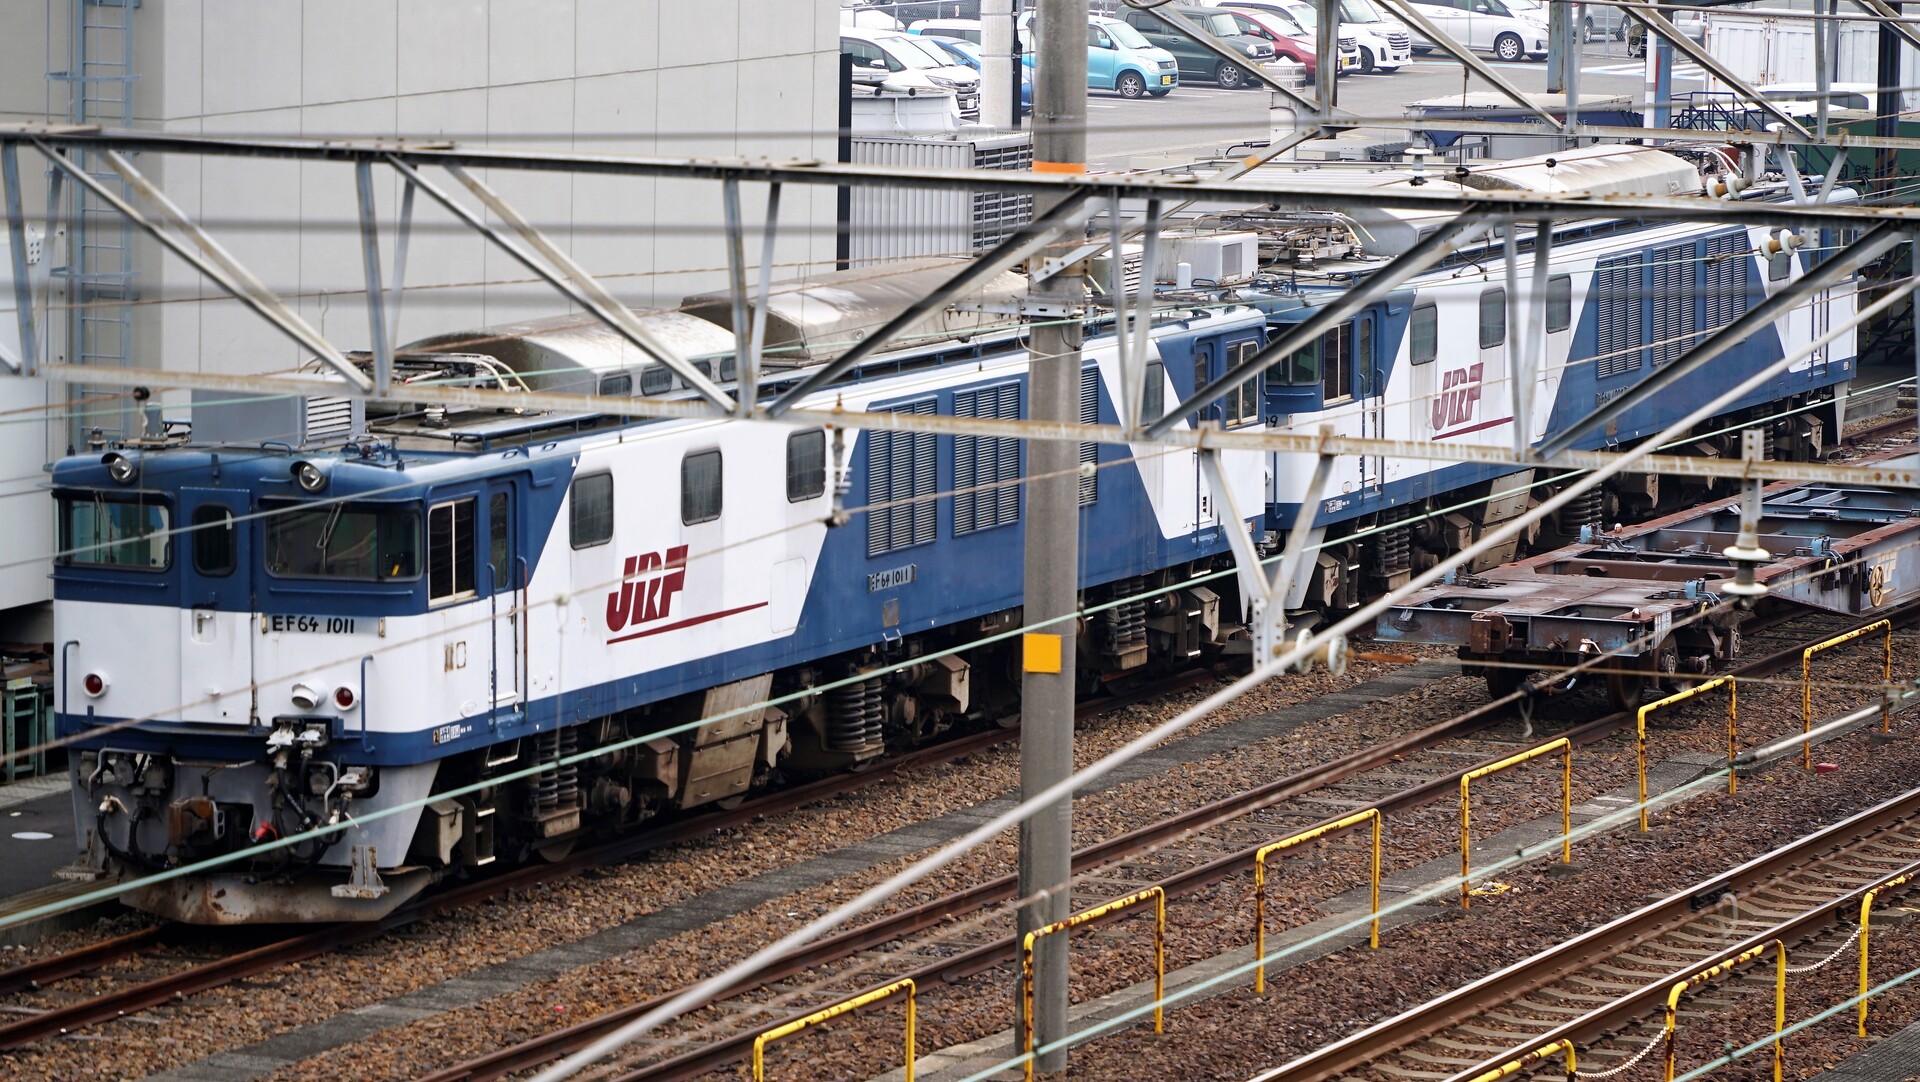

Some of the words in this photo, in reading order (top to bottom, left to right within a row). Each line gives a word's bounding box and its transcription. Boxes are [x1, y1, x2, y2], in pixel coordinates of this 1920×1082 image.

[1432, 361, 1484, 431] JRF
[606, 543, 689, 632] JRF
[871, 572, 890, 591] EF64
[892, 567, 908, 586] 1011
[272, 614, 319, 633] EF64
[326, 617, 355, 634] 1011
